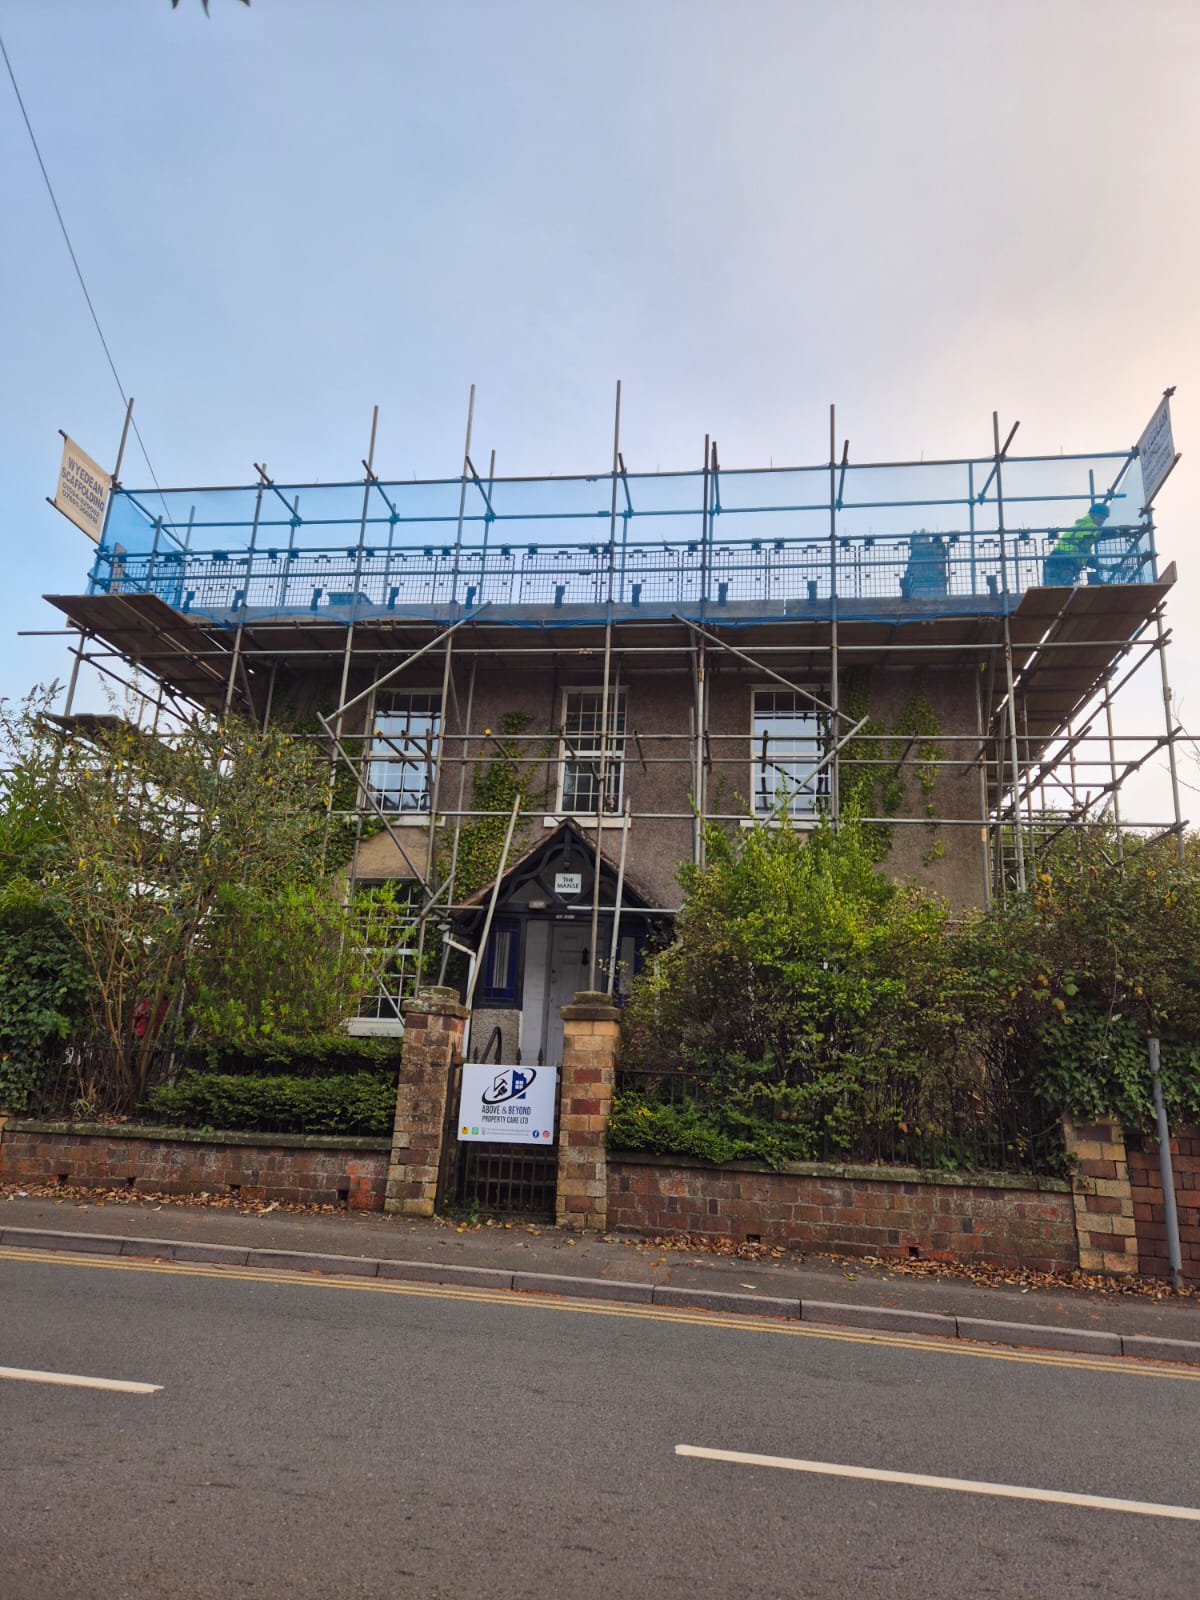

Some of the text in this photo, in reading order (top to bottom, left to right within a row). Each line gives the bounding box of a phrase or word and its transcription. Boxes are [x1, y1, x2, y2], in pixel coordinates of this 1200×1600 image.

[61, 466, 105, 512] SCAFFOLDING
[68, 456, 104, 497] WYEDEAN
[481, 1105, 531, 1115] ABOVE & BEYOND
[481, 1115, 506, 1124] PROPERTY
[506, 1116, 519, 1124] CARE
